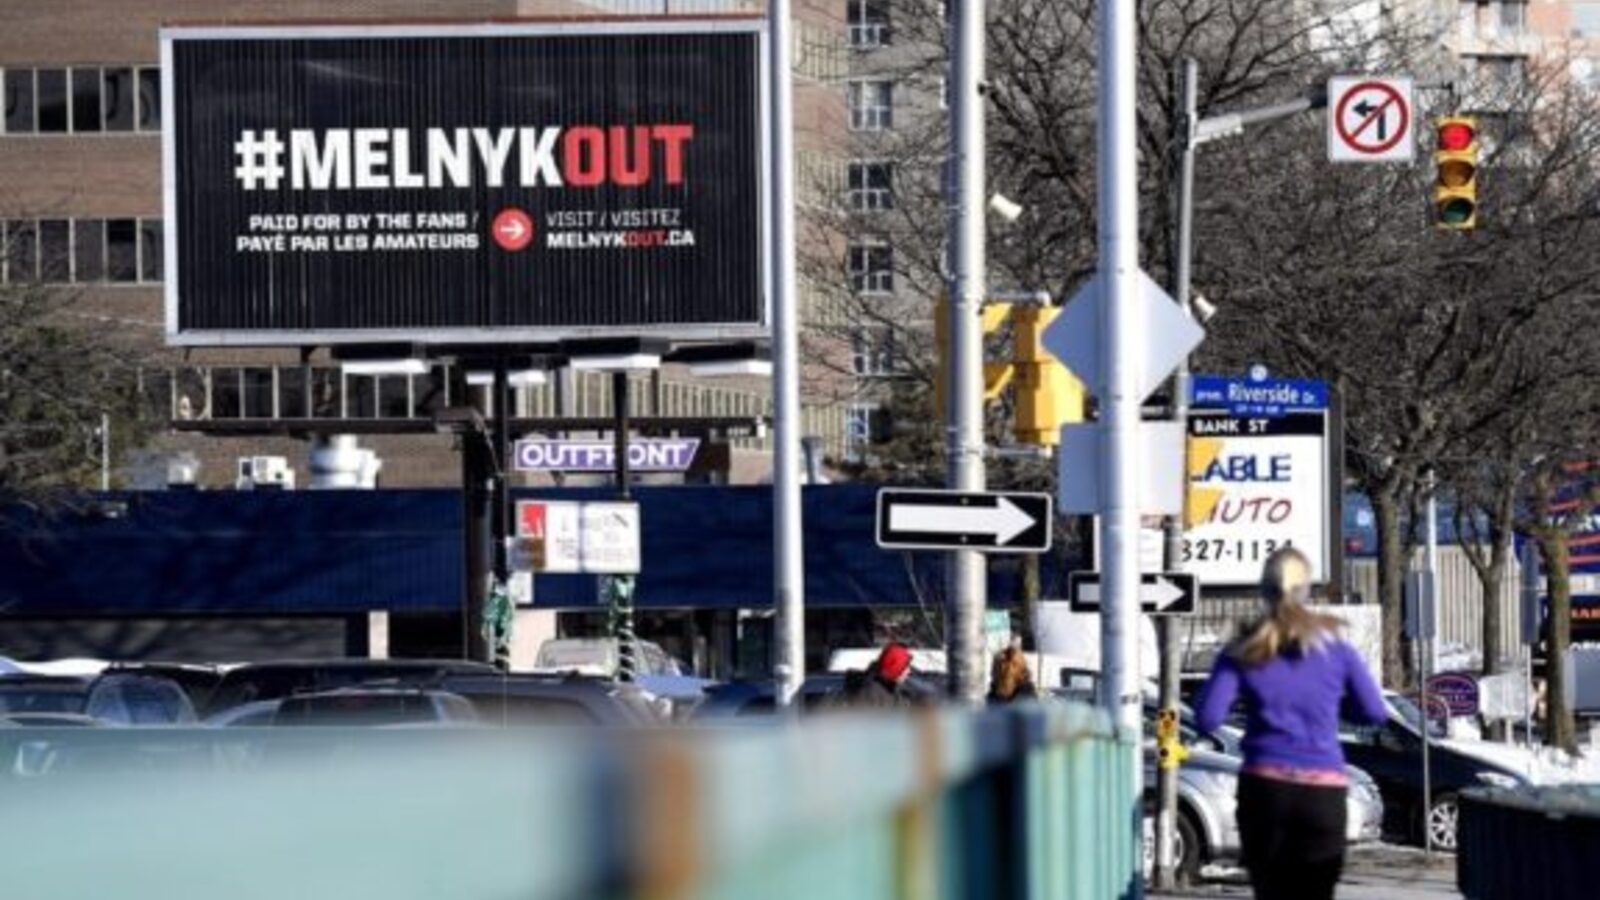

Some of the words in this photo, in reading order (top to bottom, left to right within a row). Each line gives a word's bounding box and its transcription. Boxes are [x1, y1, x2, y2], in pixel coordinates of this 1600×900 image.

[234, 124, 694, 190] #MELNYKOUT
[249, 214, 298, 231] PAID
[302, 214, 341, 230] FOR
[345, 213, 371, 230] BY
[375, 213, 412, 229] THE
[416, 212, 467, 229] FANS
[546, 210, 594, 227] VISIT
[611, 208, 681, 226] VISITEZ
[236, 232, 286, 252] PAYÉ
[291, 235, 329, 251] PAR
[333, 234, 369, 250] LES
[372, 232, 480, 250] AMATEURS
[546, 230, 695, 249] MELNYKOUT.CA
[1227, 382, 1300, 404] Riverside
[1193, 418, 1240, 433] BANK
[1248, 418, 1269, 433] ST
